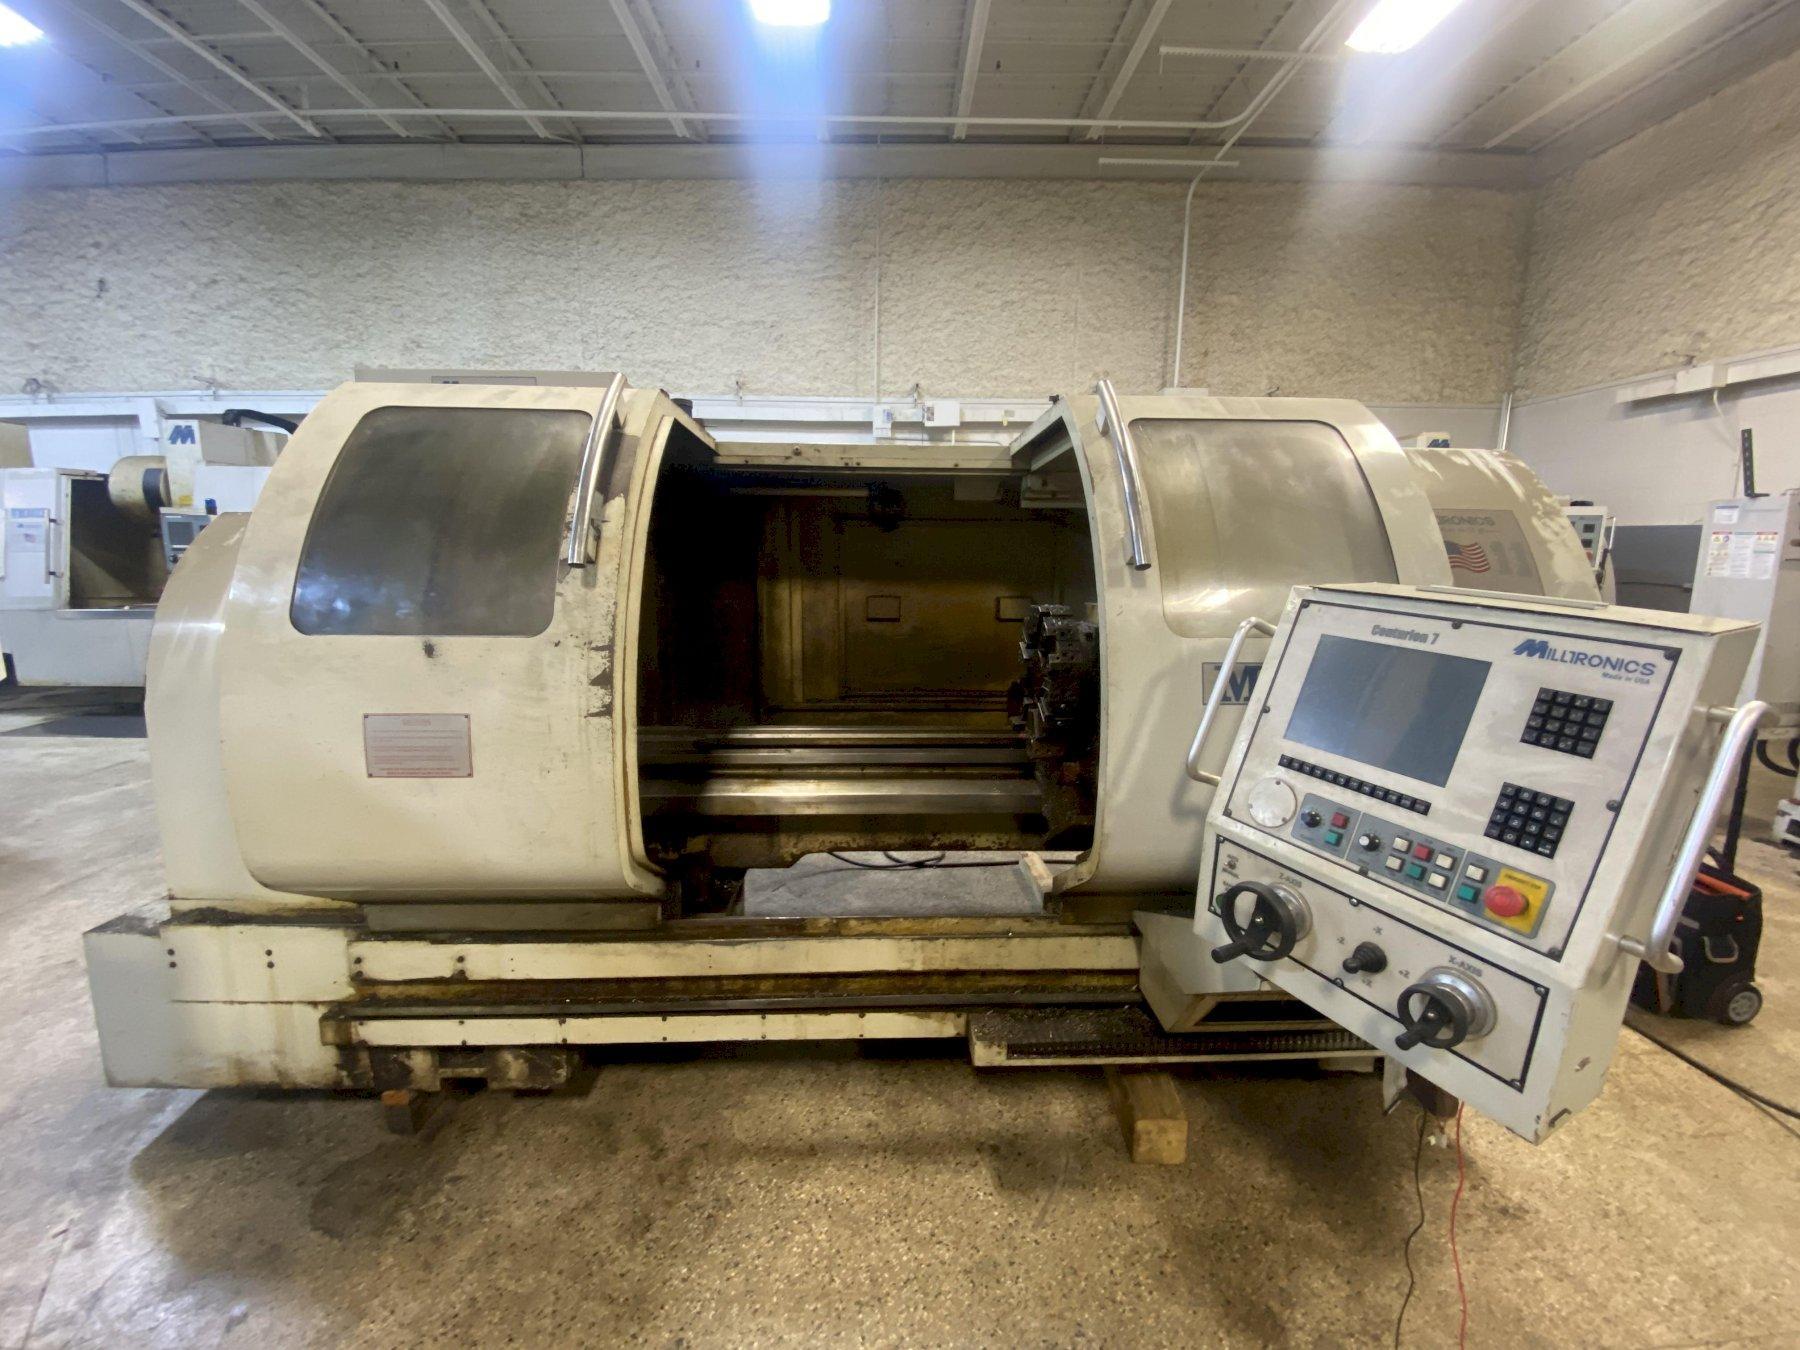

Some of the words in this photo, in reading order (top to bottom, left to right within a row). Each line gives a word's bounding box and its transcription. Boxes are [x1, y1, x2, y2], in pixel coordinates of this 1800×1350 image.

[1438, 515, 1496, 527] RONICS
[1430, 632, 1440, 645] 7
[1513, 638, 1657, 676] MILLTRONICS
